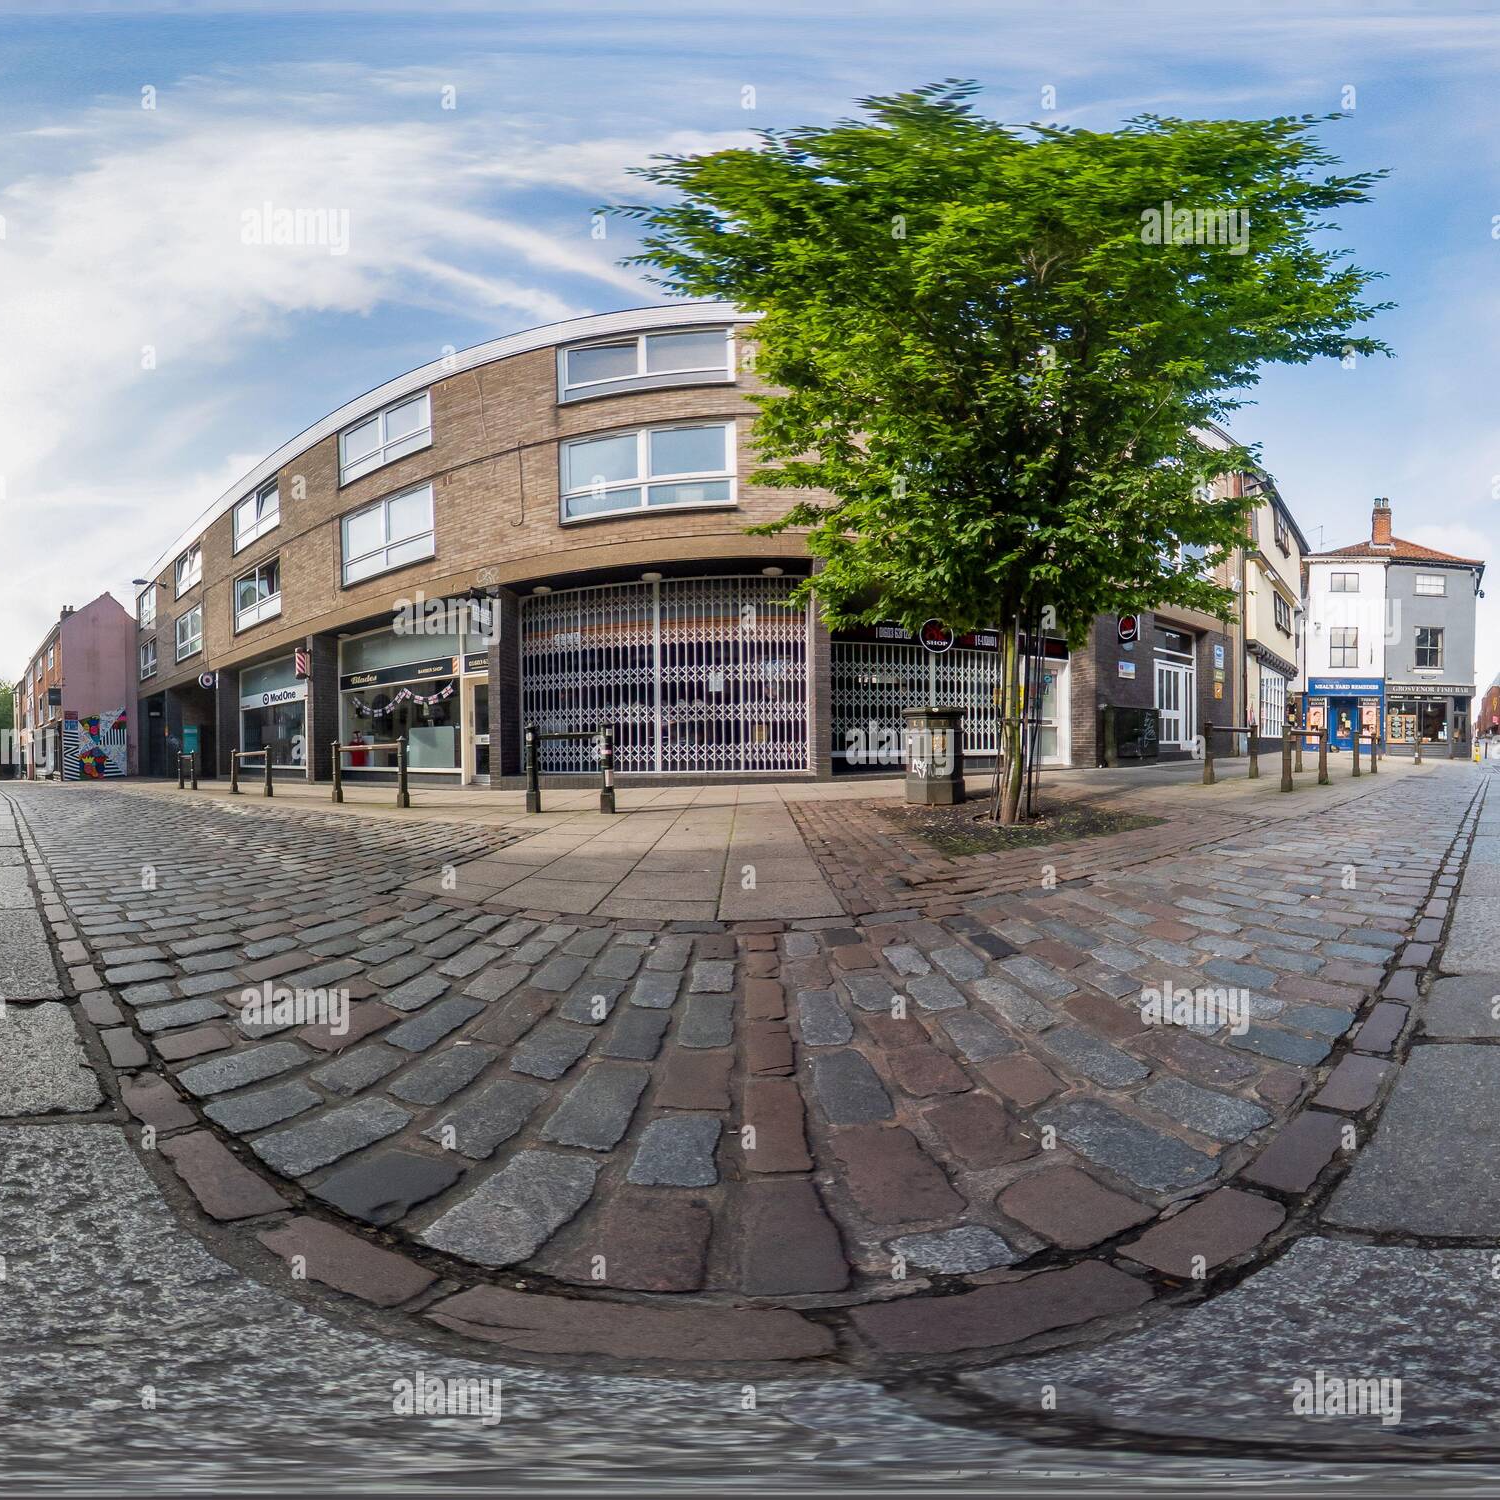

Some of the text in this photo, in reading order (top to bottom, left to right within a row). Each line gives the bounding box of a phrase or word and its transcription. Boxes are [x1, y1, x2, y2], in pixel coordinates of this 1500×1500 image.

[350, 675, 377, 685] Blades
[270, 690, 296, 703] Mod One
